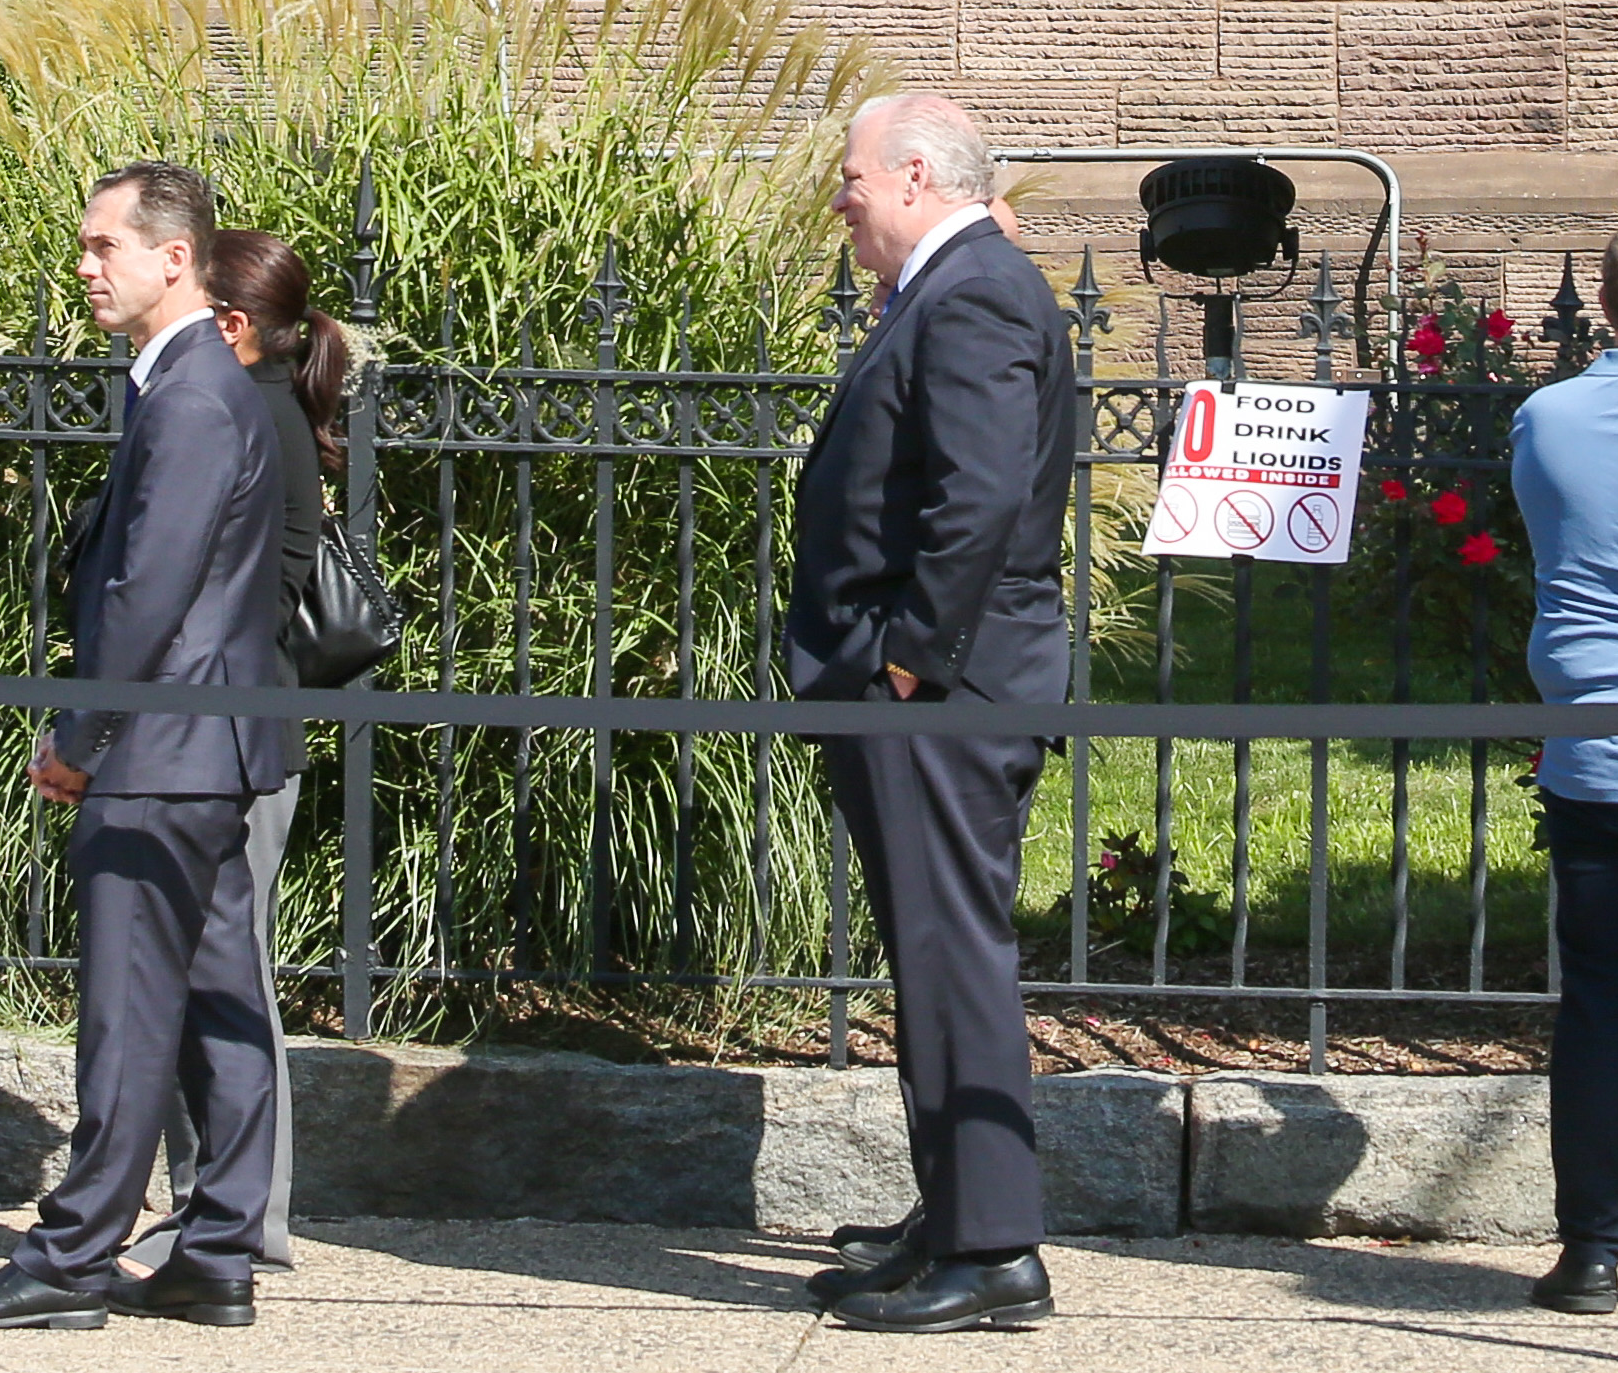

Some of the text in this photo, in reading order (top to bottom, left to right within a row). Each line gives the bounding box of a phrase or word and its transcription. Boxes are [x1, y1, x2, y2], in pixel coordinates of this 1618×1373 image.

[1236, 396, 1316, 414] FOOD
[1167, 389, 1216, 463] O
[1235, 423, 1332, 444] DRINK
[1232, 451, 1343, 472] LIQUIDS
[1261, 470, 1330, 486] INSIDE
